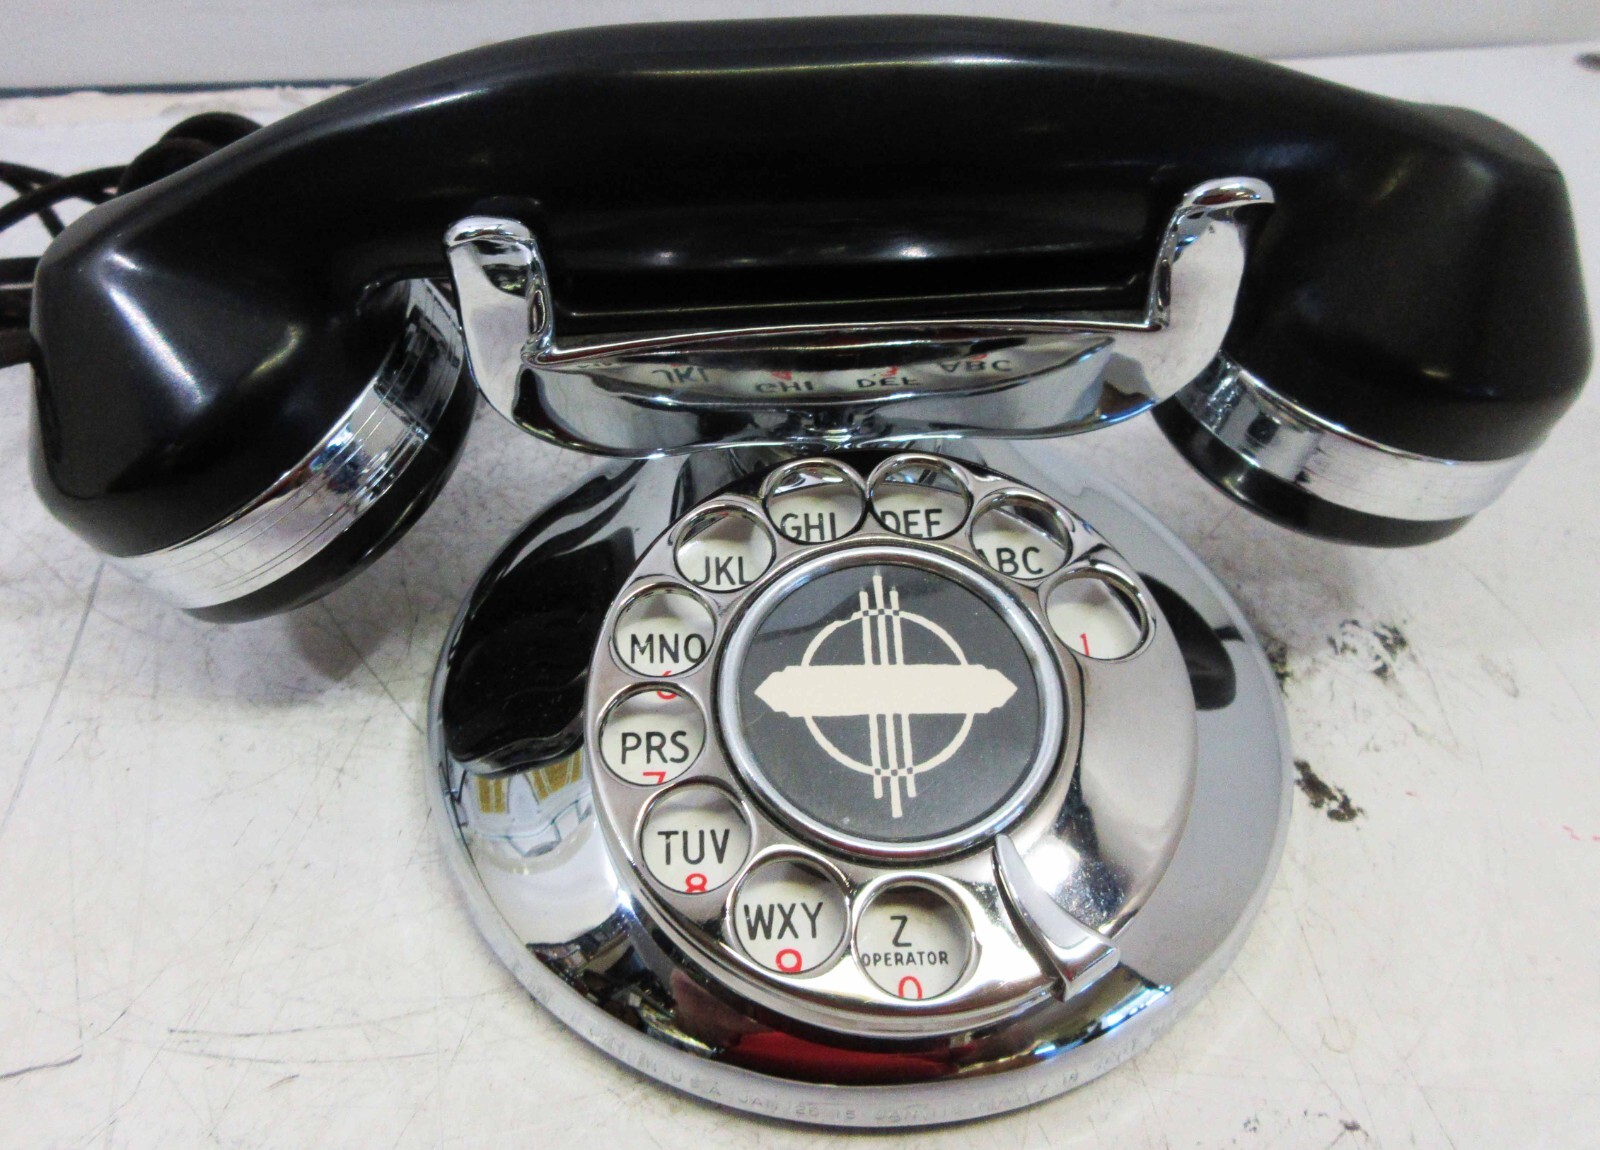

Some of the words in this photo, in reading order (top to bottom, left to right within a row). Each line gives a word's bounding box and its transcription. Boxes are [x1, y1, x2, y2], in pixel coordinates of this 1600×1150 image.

[780, 511, 838, 541] GHI
[880, 507, 943, 539] DEF
[690, 555, 754, 587] JKL
[629, 633, 707, 665] MNO
[1080, 632, 1091, 657] 1
[620, 730, 691, 765] PRS
[657, 828, 731, 866] TUV
[743, 901, 824, 941] WXY
[889, 914, 913, 948] Z
[861, 950, 949, 968] OPERATOR
